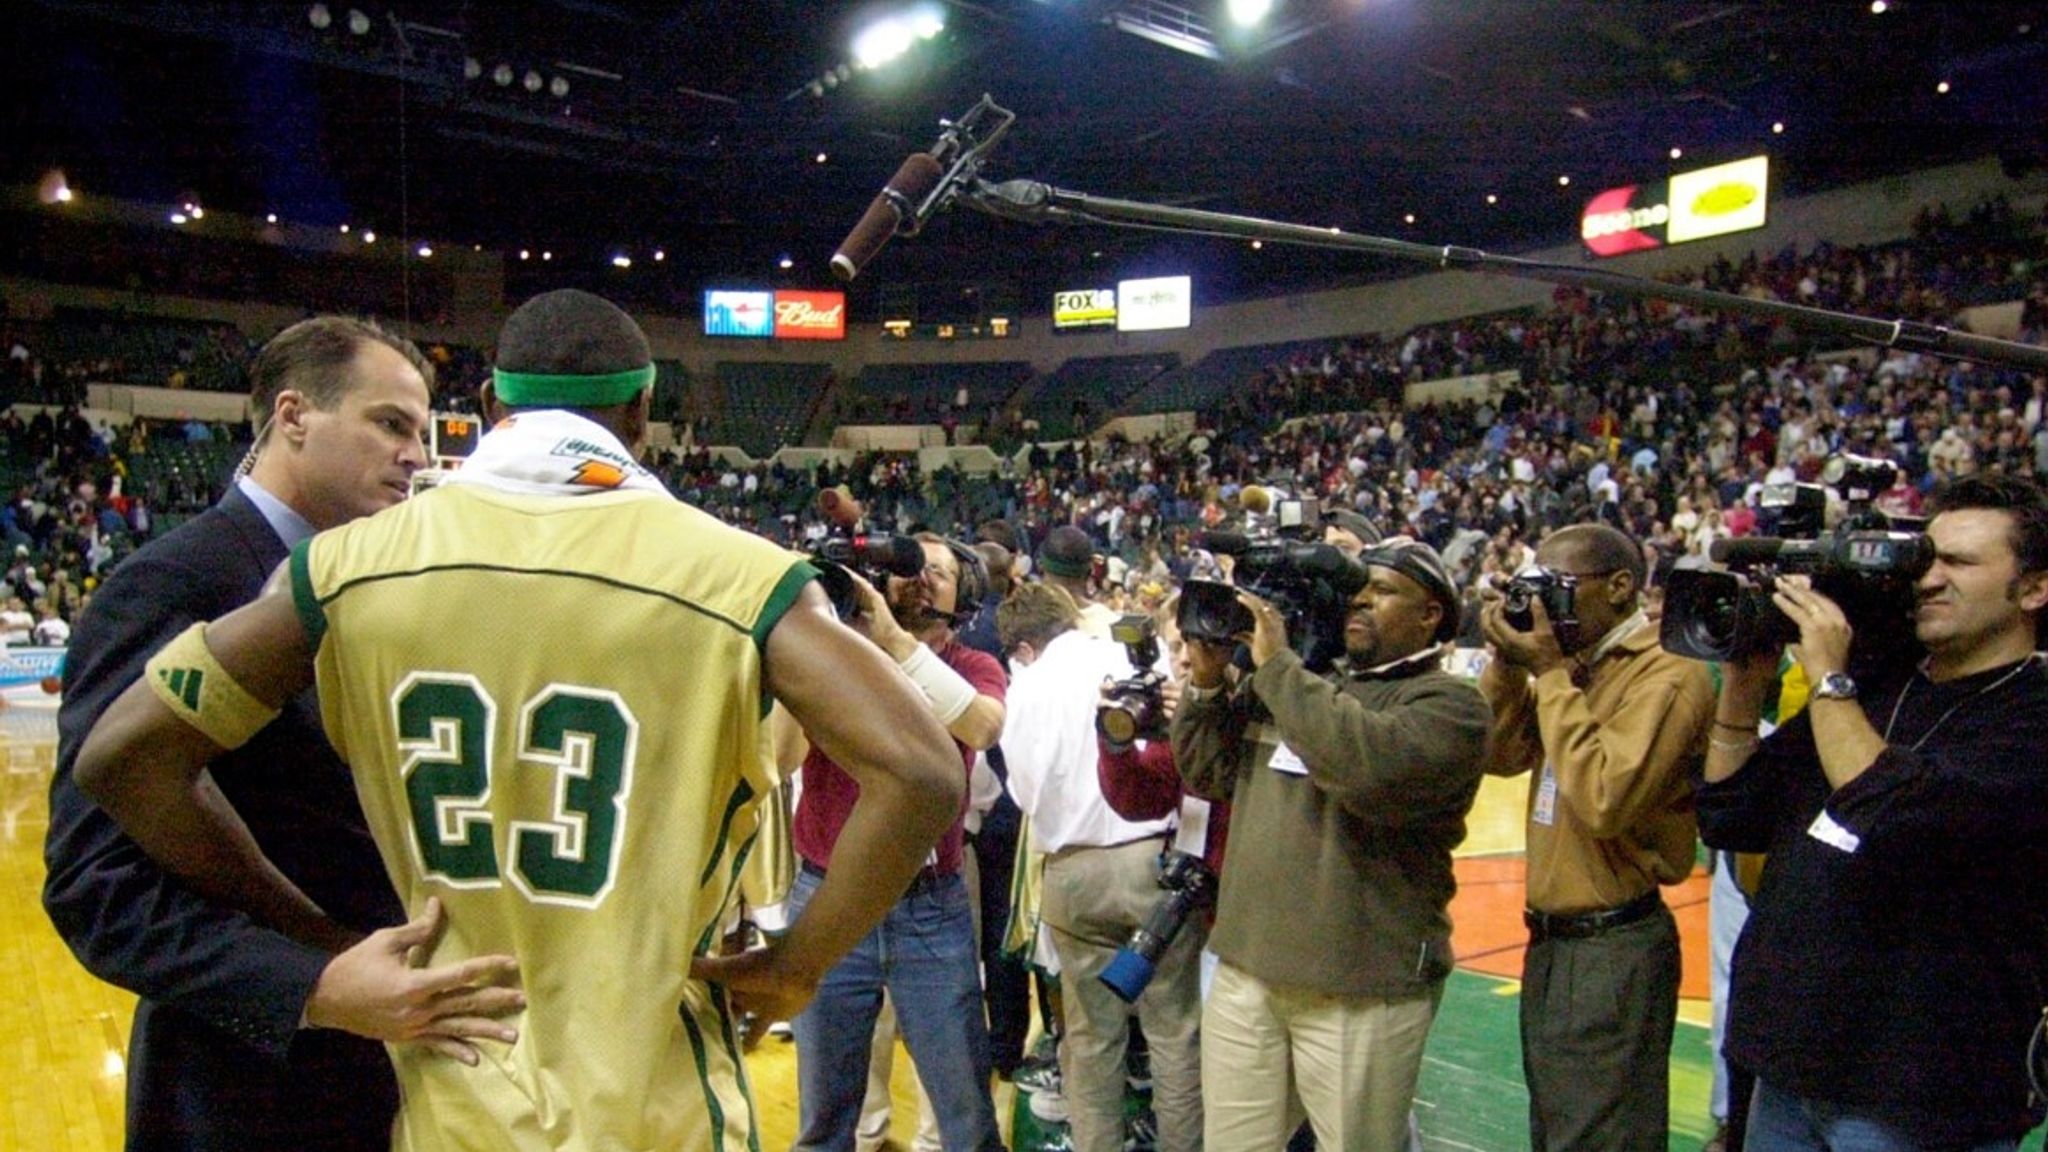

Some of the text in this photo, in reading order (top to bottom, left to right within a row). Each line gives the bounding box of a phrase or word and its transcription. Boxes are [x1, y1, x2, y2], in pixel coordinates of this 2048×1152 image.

[775, 301, 843, 326] Bud
[1057, 293, 1095, 312] FOX
[390, 671, 639, 909] 23
